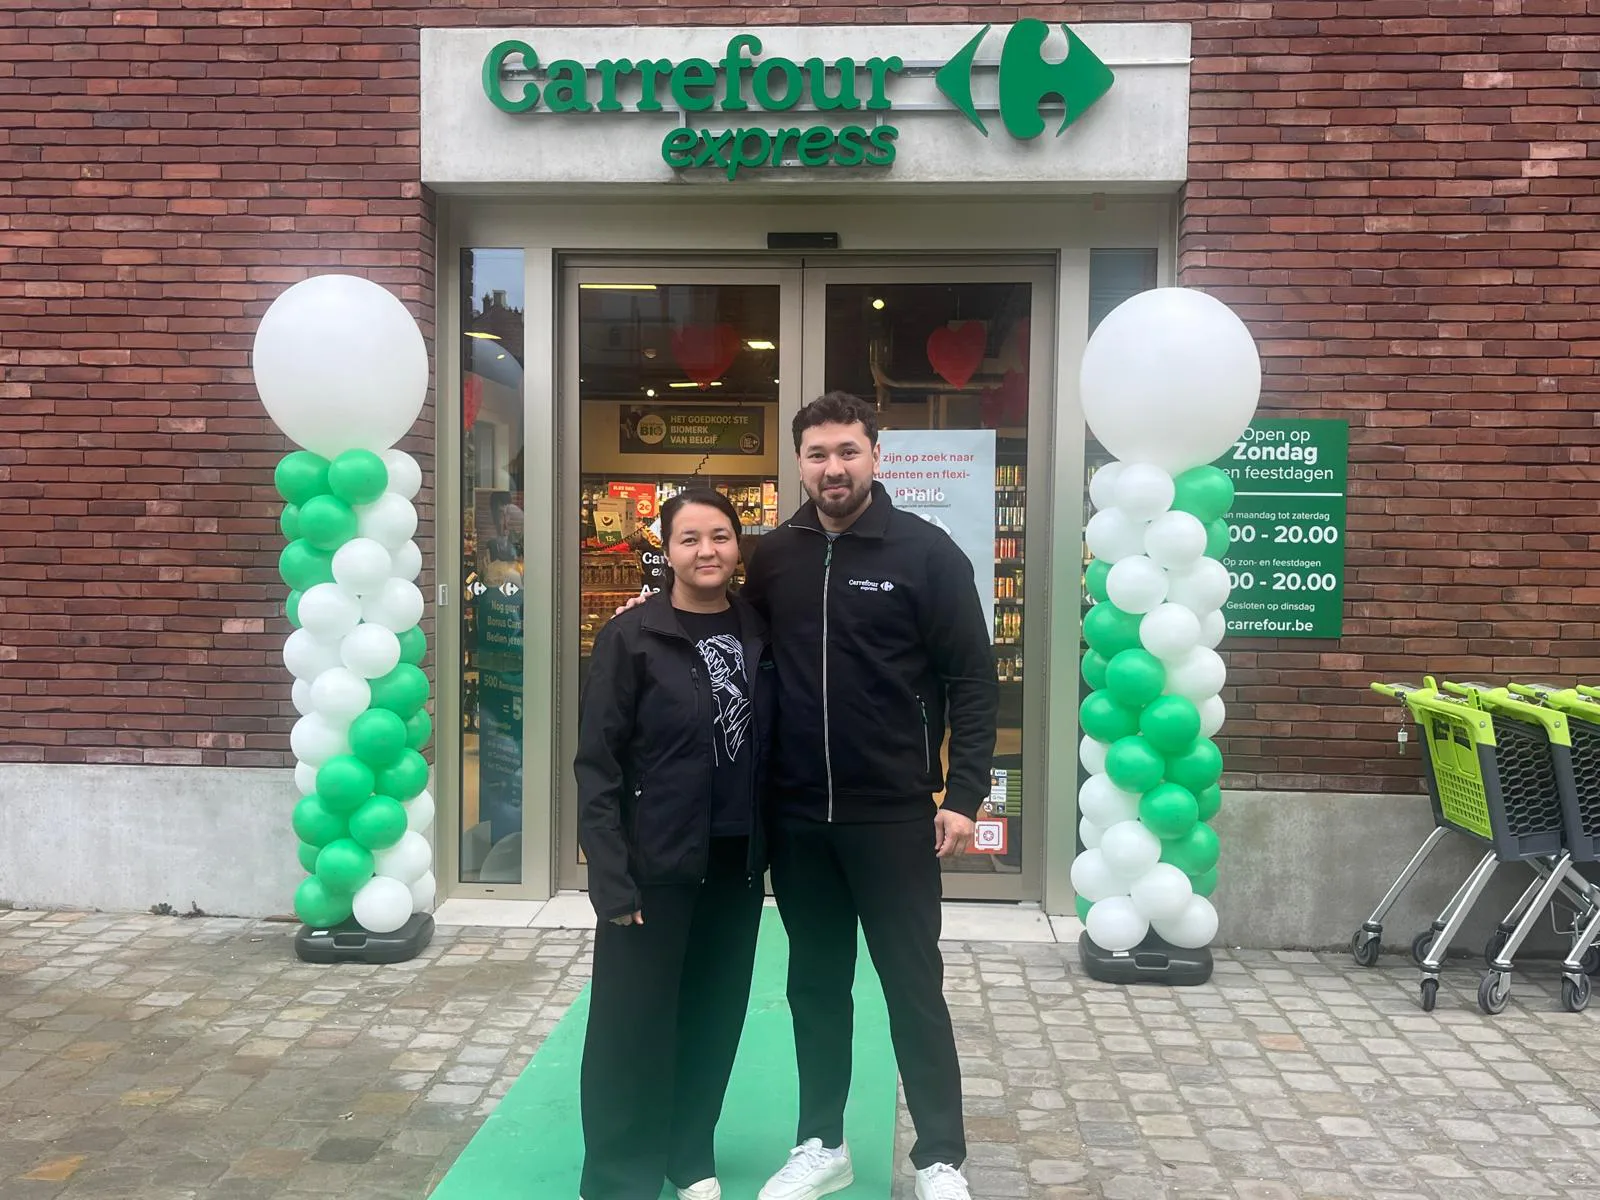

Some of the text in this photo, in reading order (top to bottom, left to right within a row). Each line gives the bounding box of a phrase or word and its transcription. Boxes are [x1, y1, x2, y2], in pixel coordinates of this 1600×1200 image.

[482, 34, 902, 113] Carrefour
[661, 124, 898, 180] express
[670, 415, 686, 424] HET
[670, 425, 709, 434] BIOMERK
[1242, 427, 1311, 444] Open op
[670, 435, 687, 445] VAN
[883, 452, 974, 464] zijn op zoek naar
[1232, 442, 1318, 466] Zondag
[873, 469, 970, 480] tudenten en flexi-
[1245, 465, 1334, 483] feestdagen
[904, 488, 945, 502] Hallo
[1223, 511, 1331, 522] an maandag tot zaterdag
[1228, 524, 1256, 543] 00
[1273, 525, 1339, 544] 20.00
[1222, 557, 1237, 568] Op
[1238, 559, 1258, 567] zon-
[1272, 558, 1322, 569] feestdagen
[848, 579, 880, 588] Carrefour
[1229, 571, 1255, 590] 00
[1272, 572, 1337, 591] 20.00
[1226, 601, 1316, 613] Gesloten op dinsdag
[1226, 618, 1314, 632] carrefour.be
